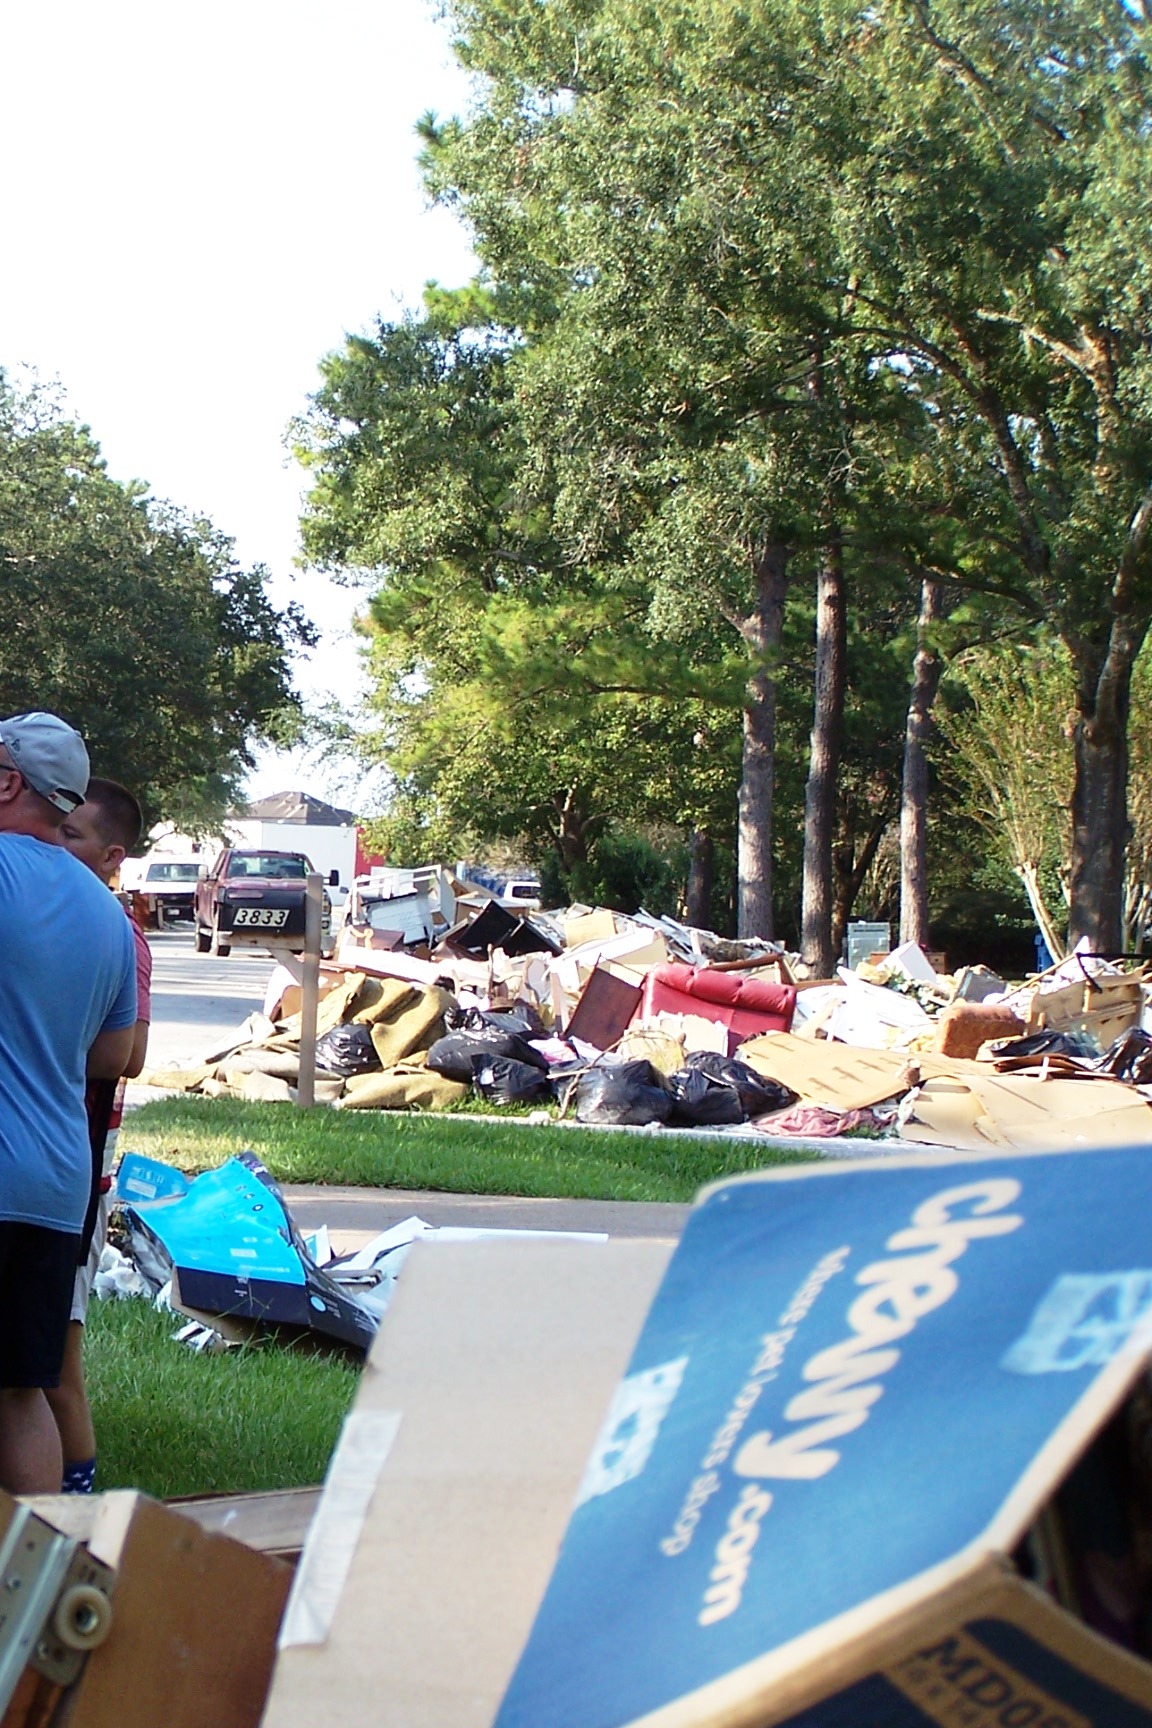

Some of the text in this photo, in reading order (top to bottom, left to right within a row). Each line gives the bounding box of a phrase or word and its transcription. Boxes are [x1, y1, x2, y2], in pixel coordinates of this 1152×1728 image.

[237, 909, 287, 926] 3833
[660, 1245, 851, 1556] where pet lovers shop
